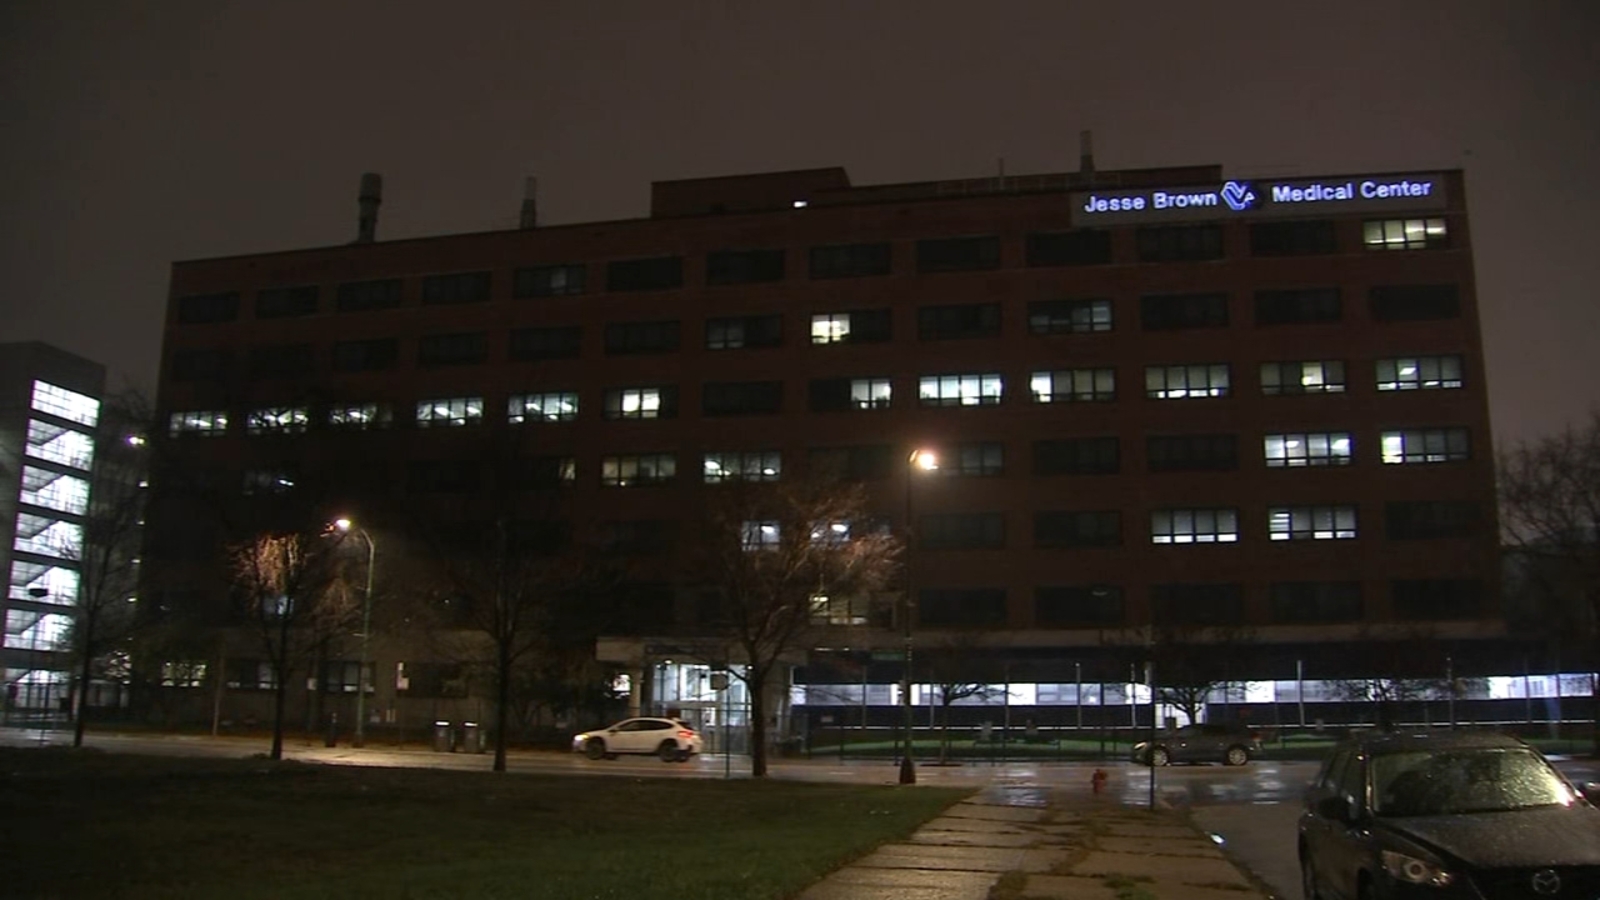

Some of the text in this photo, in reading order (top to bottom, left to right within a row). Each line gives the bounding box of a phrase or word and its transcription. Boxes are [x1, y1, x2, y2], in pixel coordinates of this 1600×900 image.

[1085, 195, 1146, 213] Jesse
[1153, 191, 1218, 209] Brown
[1272, 182, 1353, 202] Medical
[1360, 180, 1432, 199] Center
